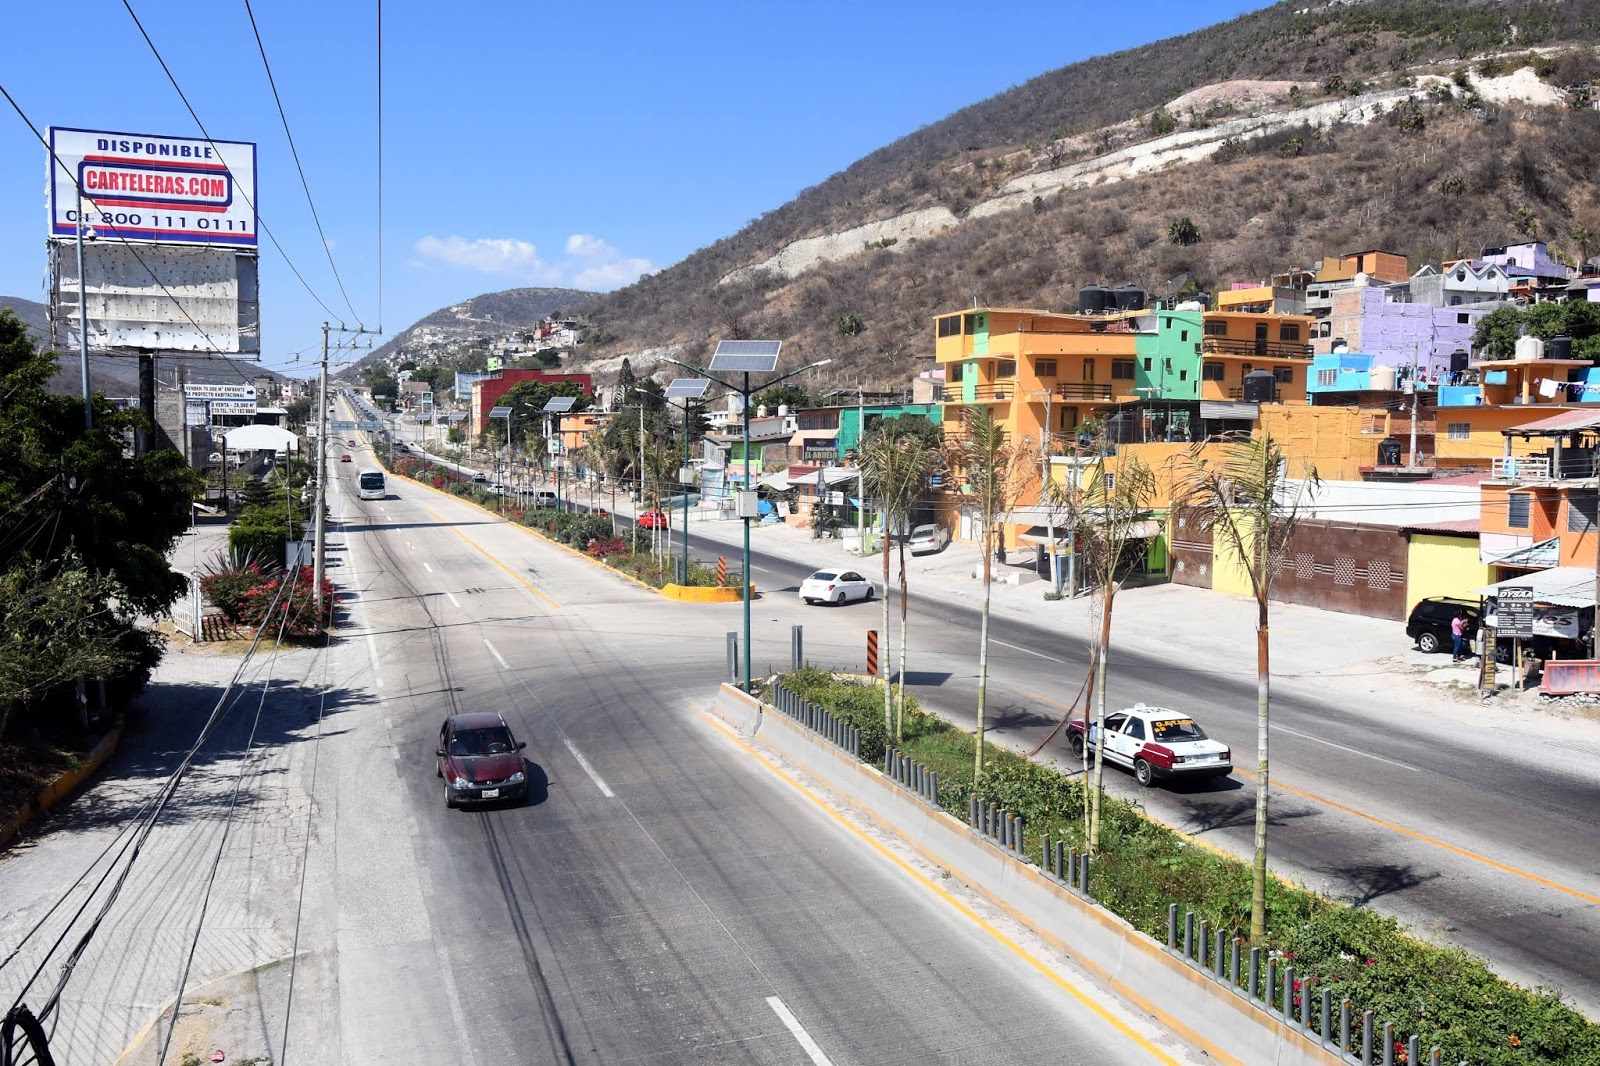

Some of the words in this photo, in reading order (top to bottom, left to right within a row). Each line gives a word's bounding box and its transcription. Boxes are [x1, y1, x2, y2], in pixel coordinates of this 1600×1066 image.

[97, 138, 212, 159] DISPONIBLE
[86, 170, 225, 197] CARTELERAS.COM
[66, 210, 90, 222] 01
[101, 212, 142, 225] 800
[151, 215, 186, 228] 111
[197, 218, 246, 231] 0111
[812, 451, 838, 459] ABUELO
